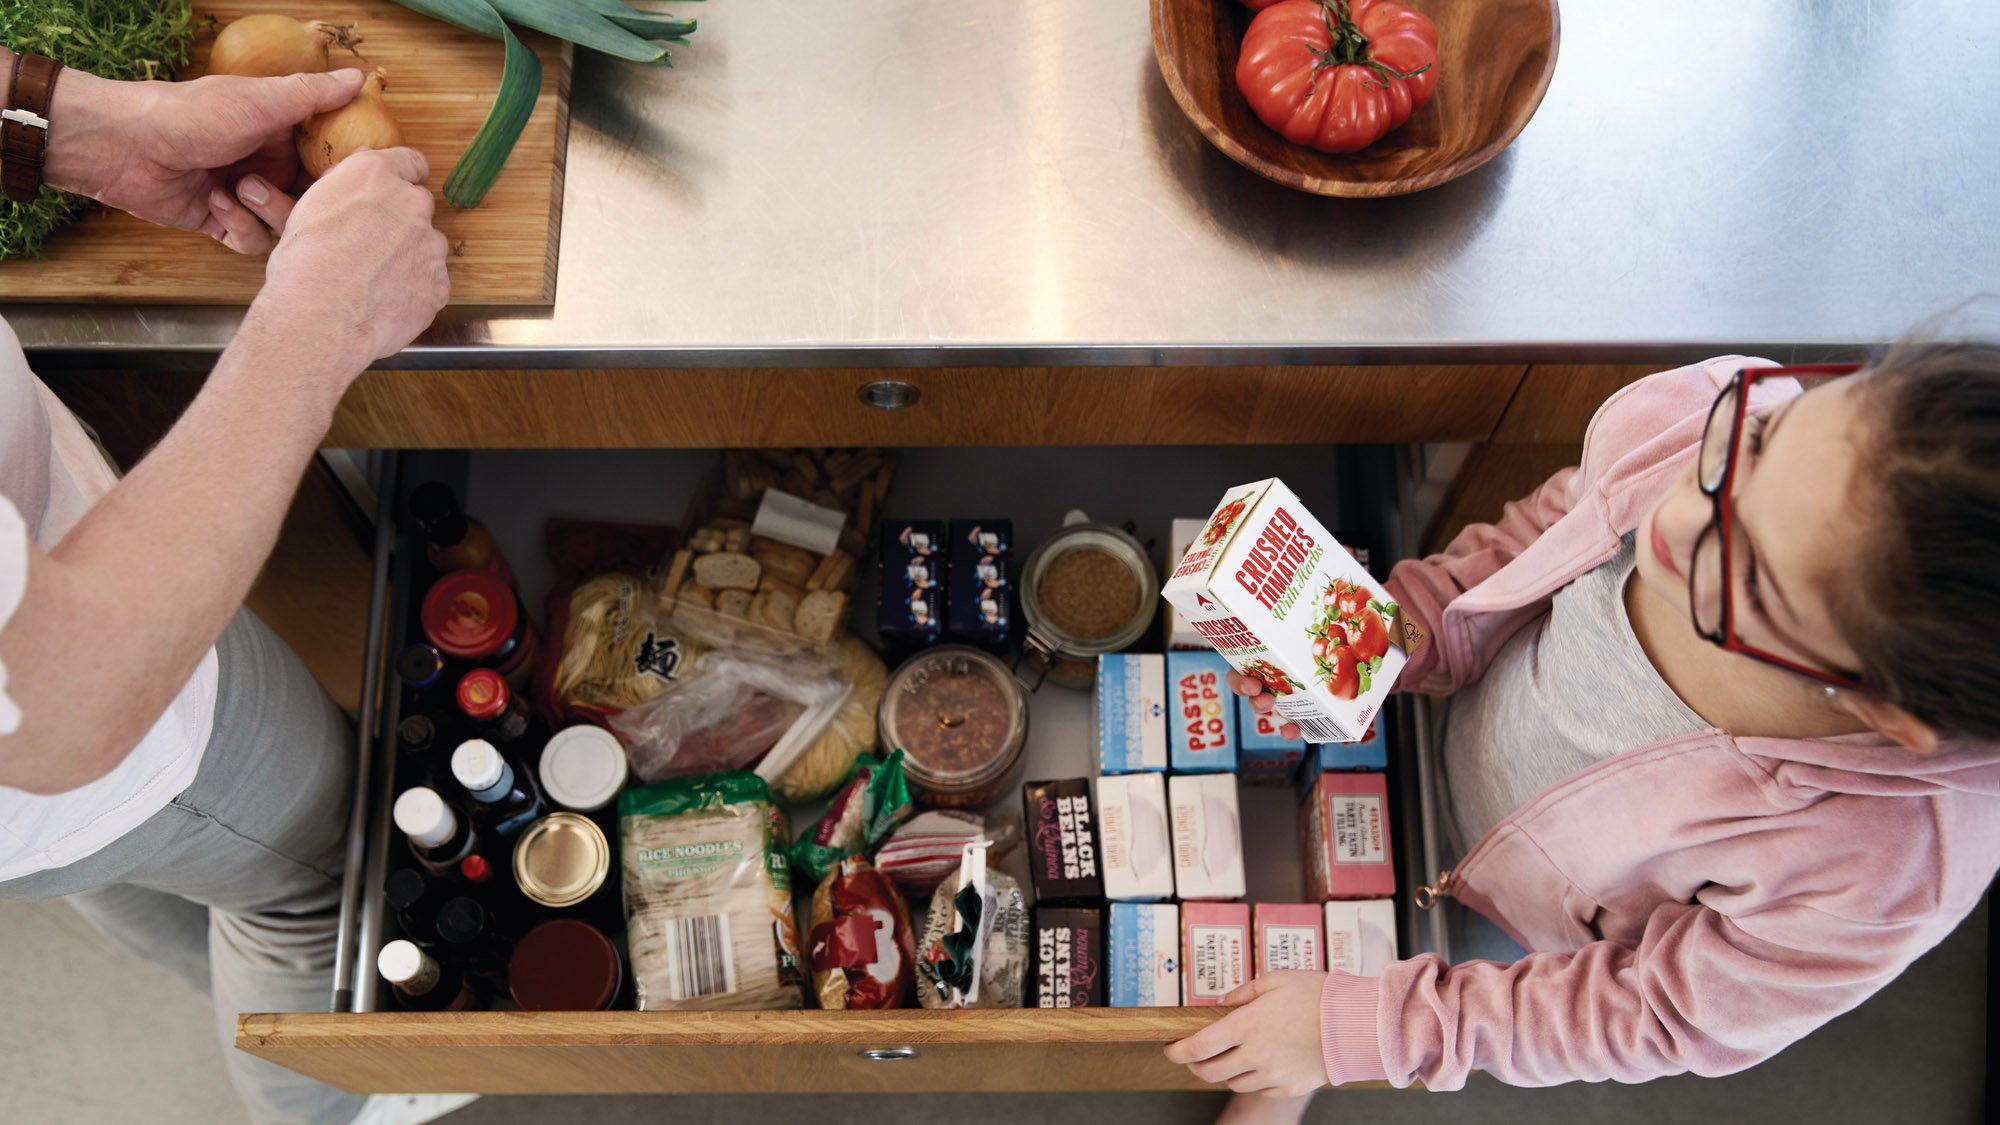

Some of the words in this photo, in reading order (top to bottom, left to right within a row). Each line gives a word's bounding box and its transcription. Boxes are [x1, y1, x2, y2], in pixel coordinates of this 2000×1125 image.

[1173, 558, 1207, 579] CRUSHED
[1235, 507, 1297, 595] CRUSHED
[1256, 527, 1315, 611] TOMATOES
[1272, 577, 1300, 621] With
[1294, 544, 1324, 589] Herbs
[1191, 616, 1248, 638] CRUSHED
[1206, 632, 1261, 650] TOMATOES
[1237, 644, 1269, 656] Herbs
[1180, 673, 1206, 751] PASTA
[1200, 672, 1225, 747] LOOPS
[1356, 704, 1373, 726] 500ml
[637, 847, 672, 863] RICE
[674, 839, 743, 858] NOODLES
[1034, 820, 1066, 880] Quinoa
[1056, 796, 1080, 880] BEANS
[1072, 795, 1096, 878] BLACK
[1039, 928, 1054, 1008] BLACK
[1055, 927, 1071, 1008] BEANS
[1064, 928, 1097, 989] Quinoa
